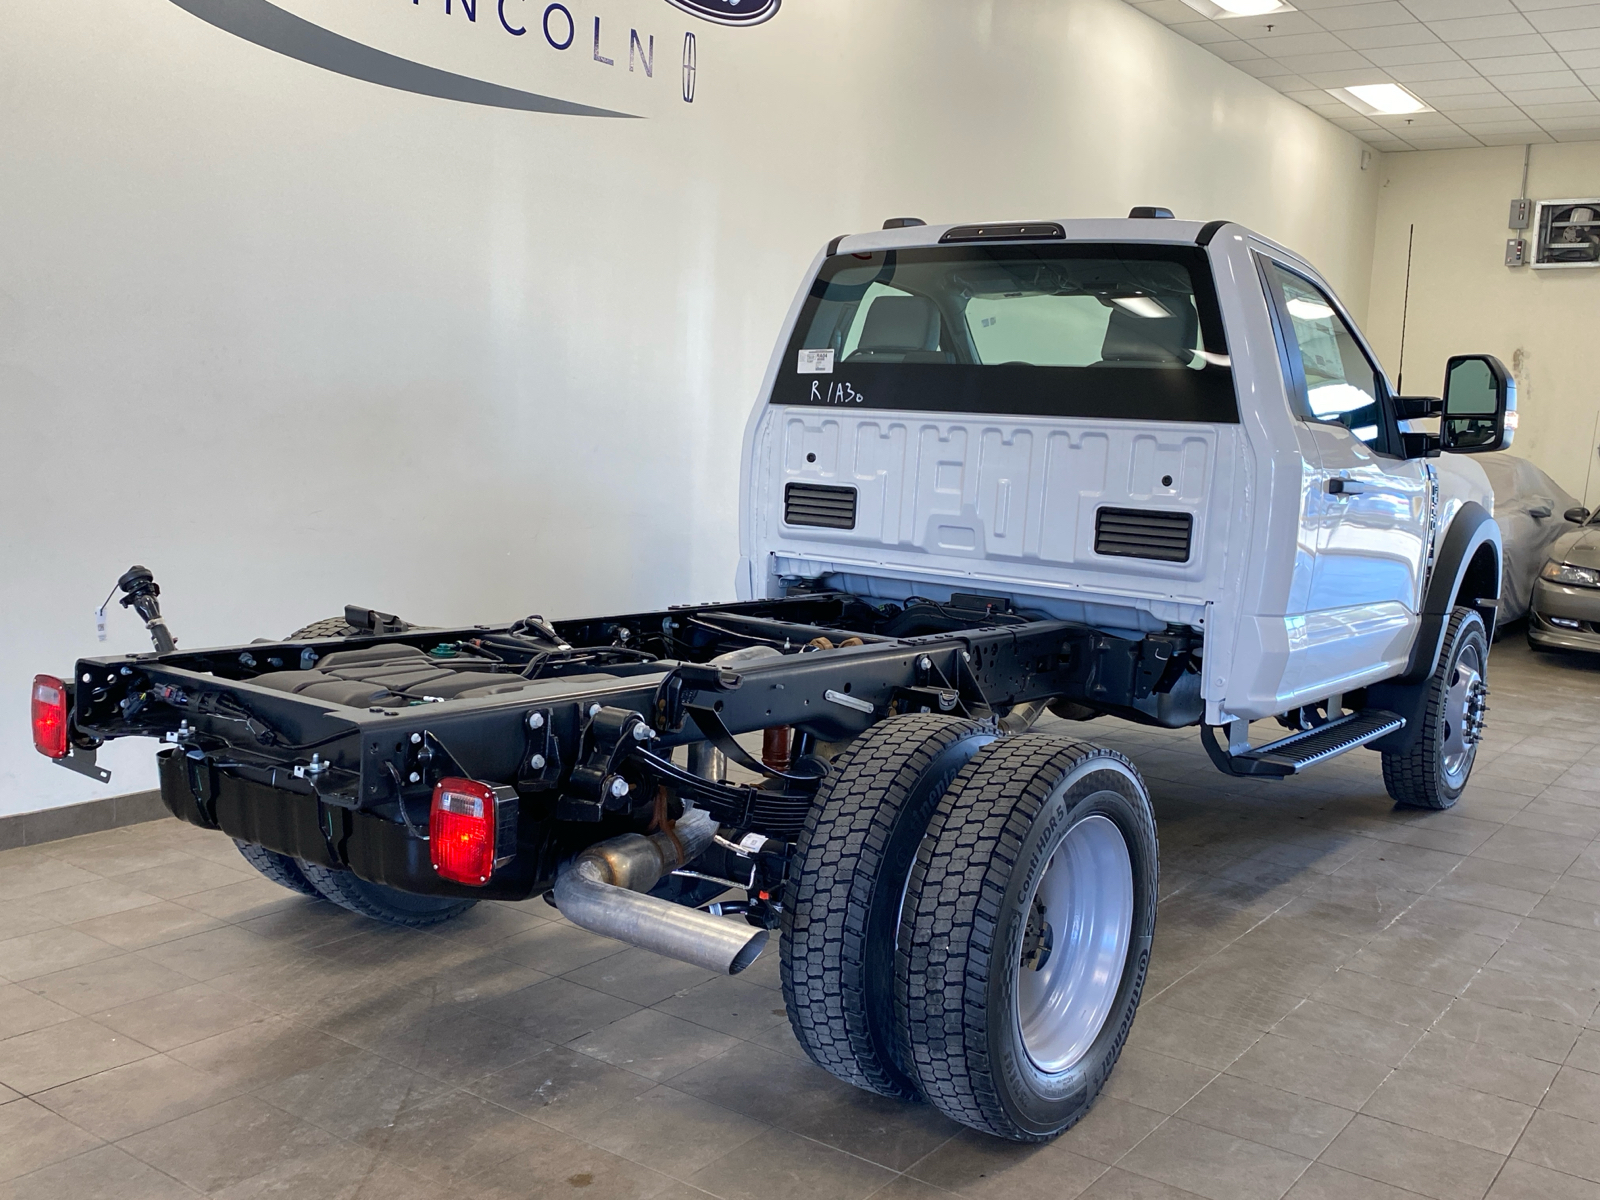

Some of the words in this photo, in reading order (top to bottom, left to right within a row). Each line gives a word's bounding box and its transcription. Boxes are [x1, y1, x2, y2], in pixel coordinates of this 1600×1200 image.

[412, 0, 655, 78] COLN
[1017, 852, 1040, 905] Conti
[1036, 816, 1058, 854] HDR
[1055, 804, 1064, 822] 5
[1102, 948, 1149, 1077] Continental
